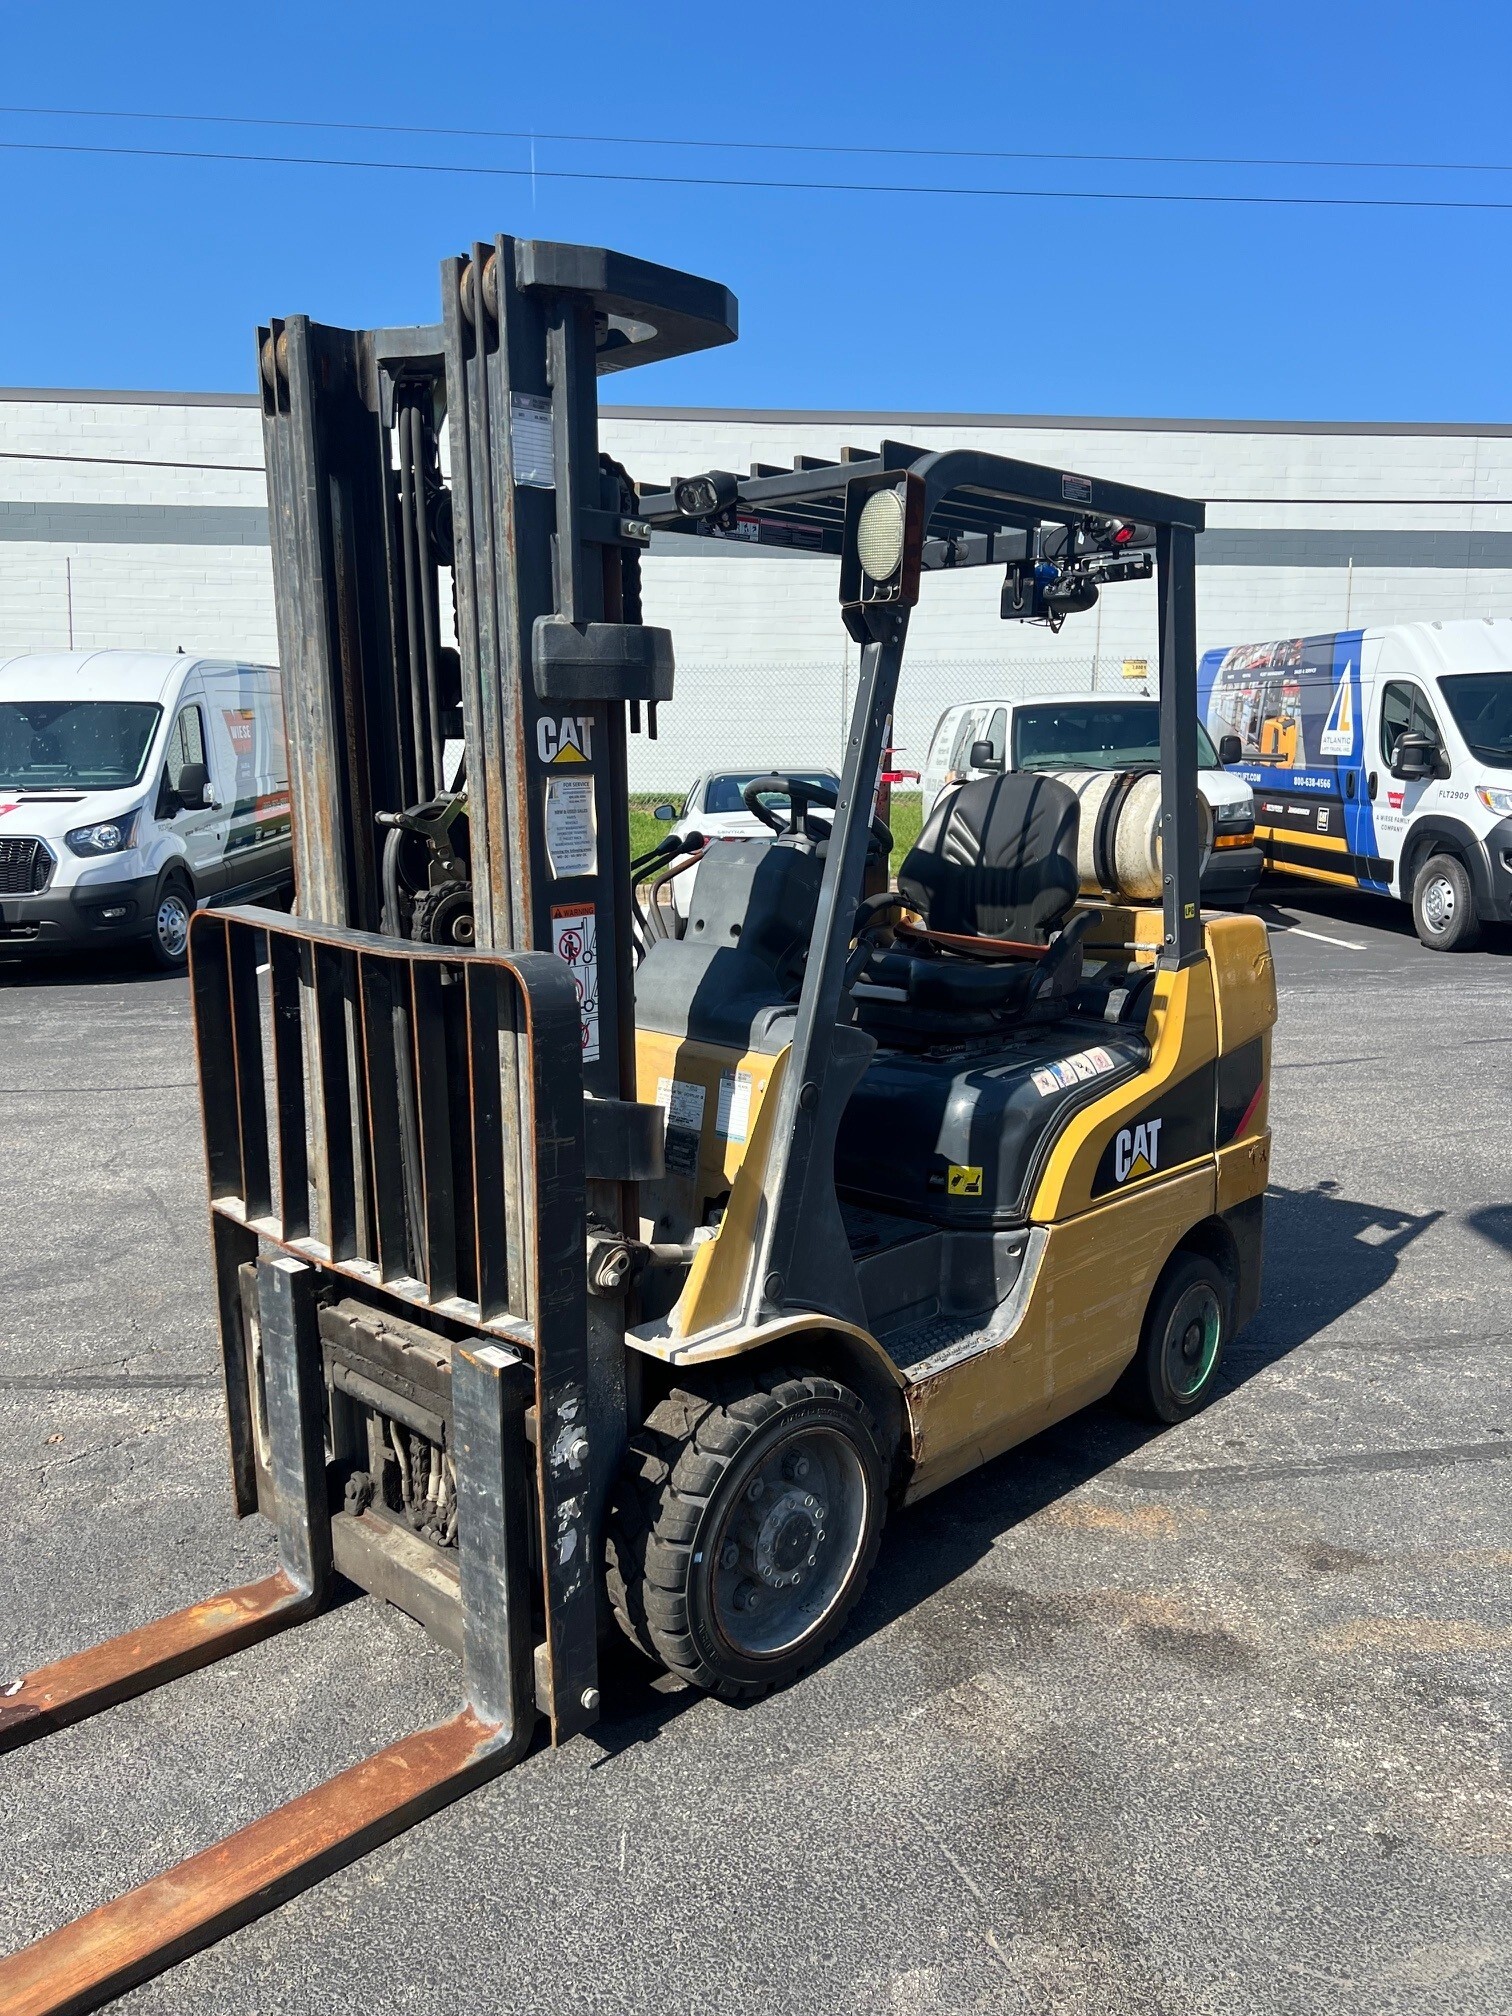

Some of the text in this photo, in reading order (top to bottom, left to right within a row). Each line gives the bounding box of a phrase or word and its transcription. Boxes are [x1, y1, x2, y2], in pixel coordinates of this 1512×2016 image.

[230, 725, 252, 739] WIESE
[536, 716, 595, 763] CAT
[1323, 736, 1351, 744] ATLANTIC
[1294, 776, 1331, 788] 800-638-4566
[1438, 790, 1470, 800] FLT2909
[1394, 816, 1411, 825] FAMILY
[1380, 824, 1404, 832] COMPANY
[563, 907, 594, 917] WARNING
[1114, 1118, 1162, 1183] CAT
